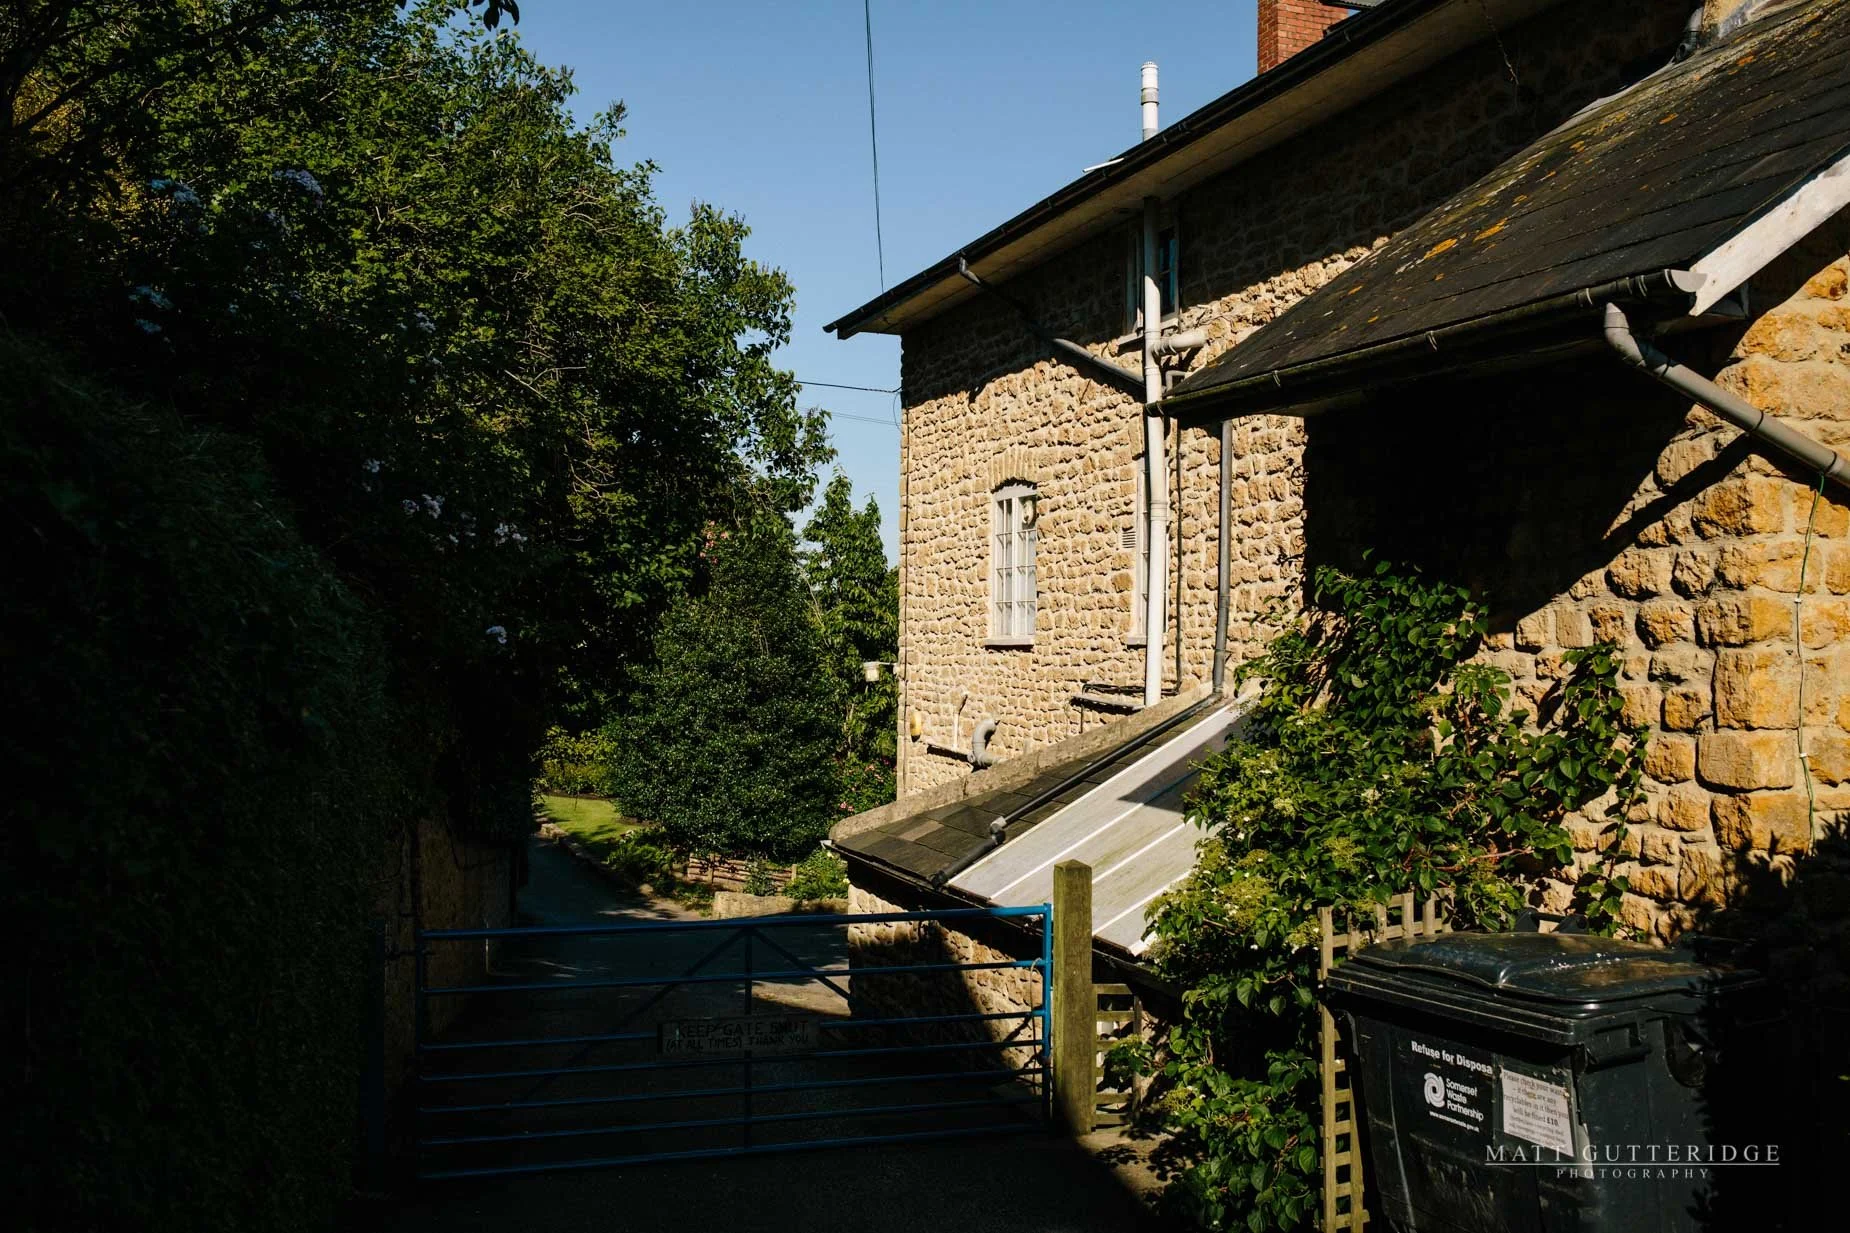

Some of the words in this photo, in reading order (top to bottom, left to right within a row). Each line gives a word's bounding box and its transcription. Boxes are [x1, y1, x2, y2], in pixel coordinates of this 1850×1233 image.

[678, 1023, 717, 1038] KEEP
[723, 1022, 764, 1036] GATE
[686, 1039, 704, 1050] ALL
[749, 1035, 785, 1046] THANK
[787, 1033, 809, 1045] YOU
[1411, 1040, 1441, 1059] Refuse
[1441, 1049, 1455, 1065] for
[1455, 1053, 1493, 1074] Disposa
[1446, 1078, 1478, 1097] Somerset
[1446, 1088, 1467, 1104] Waste
[1447, 1100, 1484, 1122] Partnership
